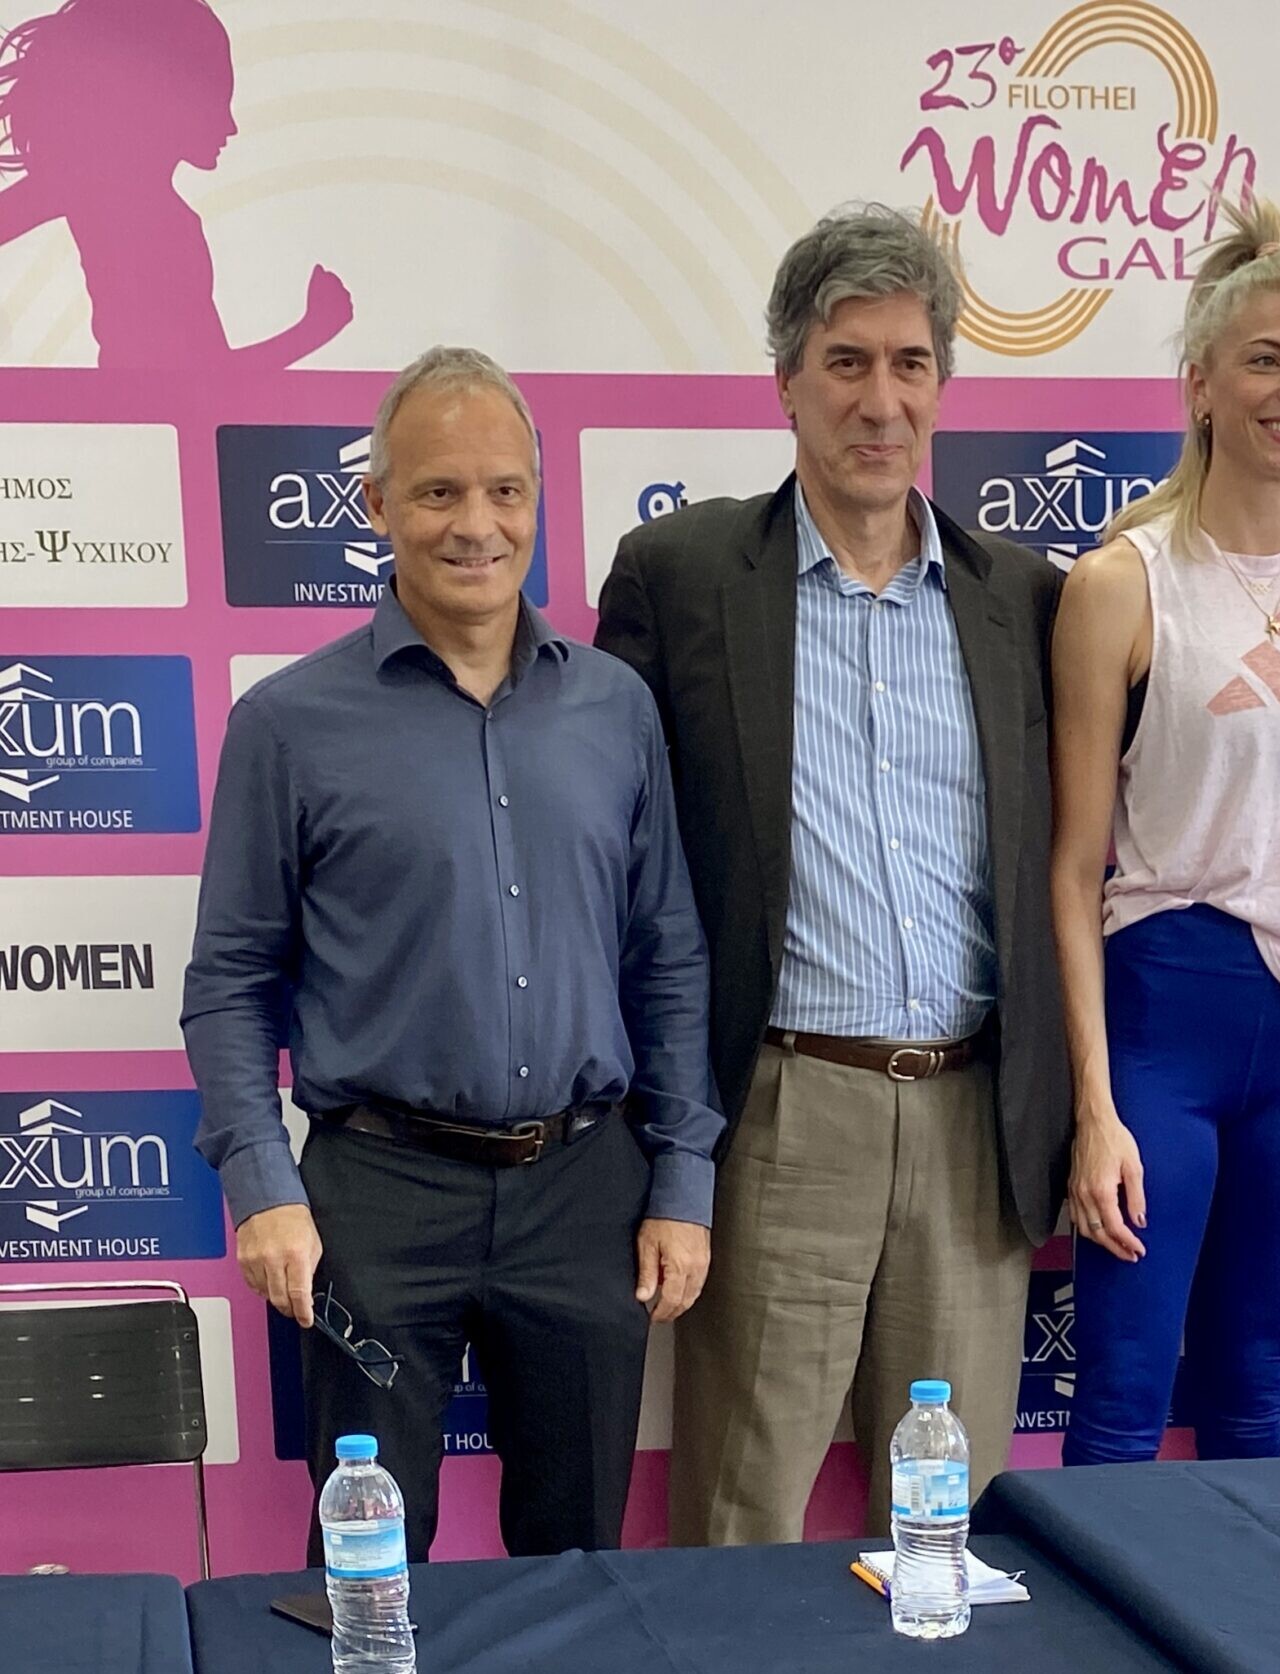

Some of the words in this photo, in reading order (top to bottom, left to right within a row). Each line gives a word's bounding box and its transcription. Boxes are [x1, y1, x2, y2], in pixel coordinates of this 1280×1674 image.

[1007, 84, 1136, 111] FILOTHEI
[1057, 237, 1199, 281] GAL
[0, 478, 73, 500] ΗΜΟΣ
[268, 473, 372, 530] ax
[294, 583, 385, 602] INVESTME
[46, 757, 76, 768] group
[78, 754, 89, 766] of
[90, 755, 143, 768] companies
[69, 809, 133, 828] HOUSE
[0, 1134, 169, 1188] xum
[75, 1189, 105, 1198] group
[106, 1186, 117, 1195] of
[118, 1186, 170, 1197] companies
[0, 1239, 92, 1258] VESTMENT
[97, 1238, 160, 1256] HOUSE
